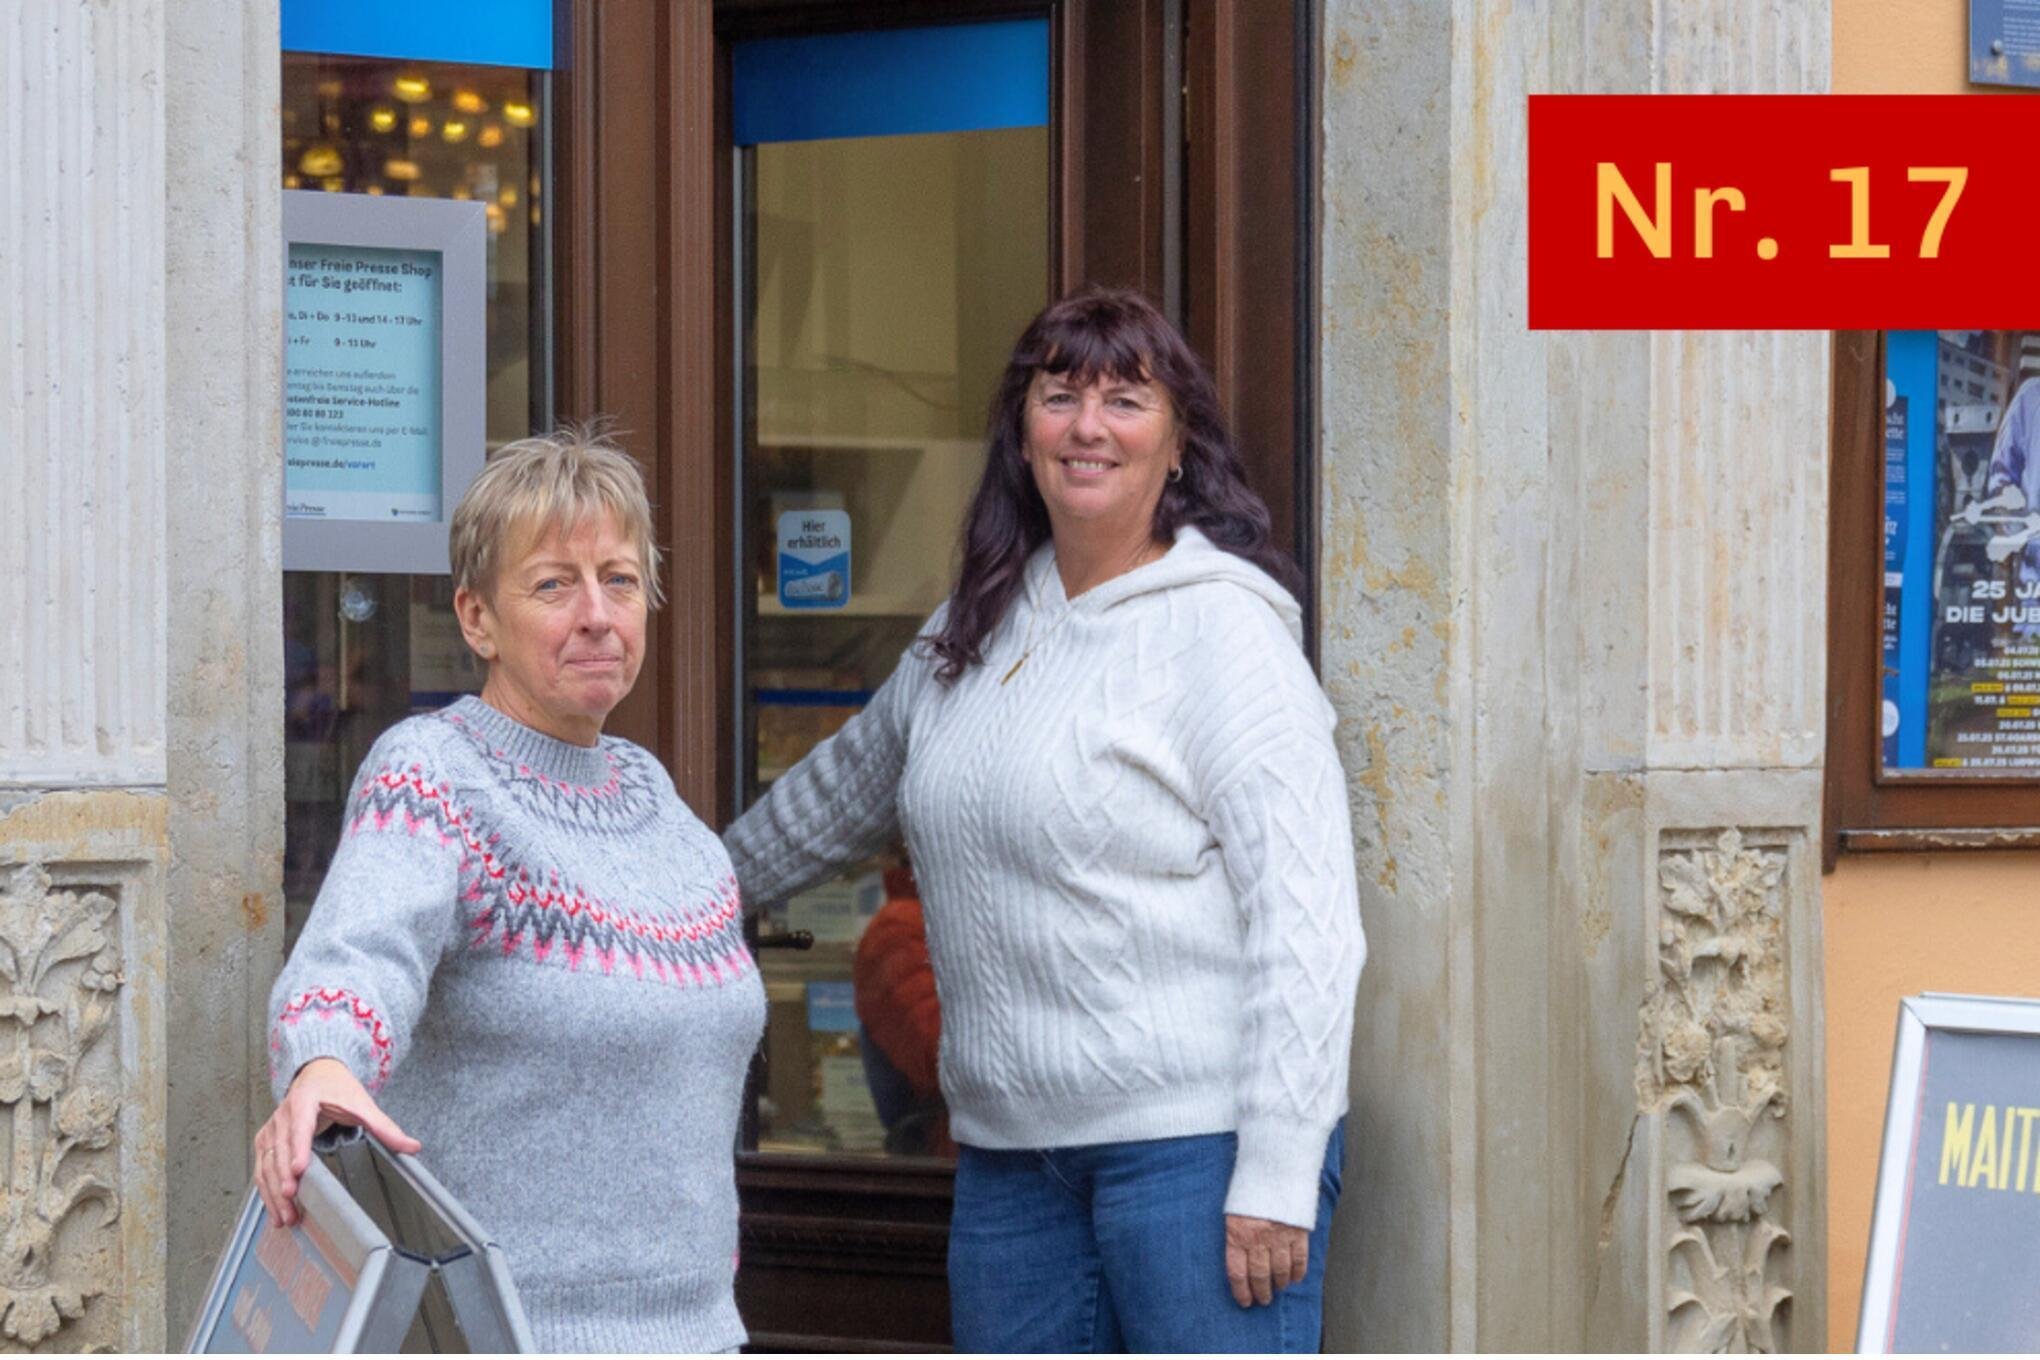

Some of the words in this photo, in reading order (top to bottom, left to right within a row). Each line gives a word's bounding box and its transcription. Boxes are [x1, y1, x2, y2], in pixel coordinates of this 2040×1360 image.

[320, 258, 353, 272] Freie
[356, 260, 399, 274] Presse
[401, 262, 433, 281] Shop
[300, 274, 319, 288] für
[322, 275, 342, 289] Sie
[344, 277, 402, 294] geöffnet:
[802, 519, 825, 533] Hier
[787, 534, 841, 550] erhältlich
[1971, 580, 2006, 599] 25
[1945, 606, 1985, 623] DIE
[1938, 1101, 2040, 1194] MAIT
